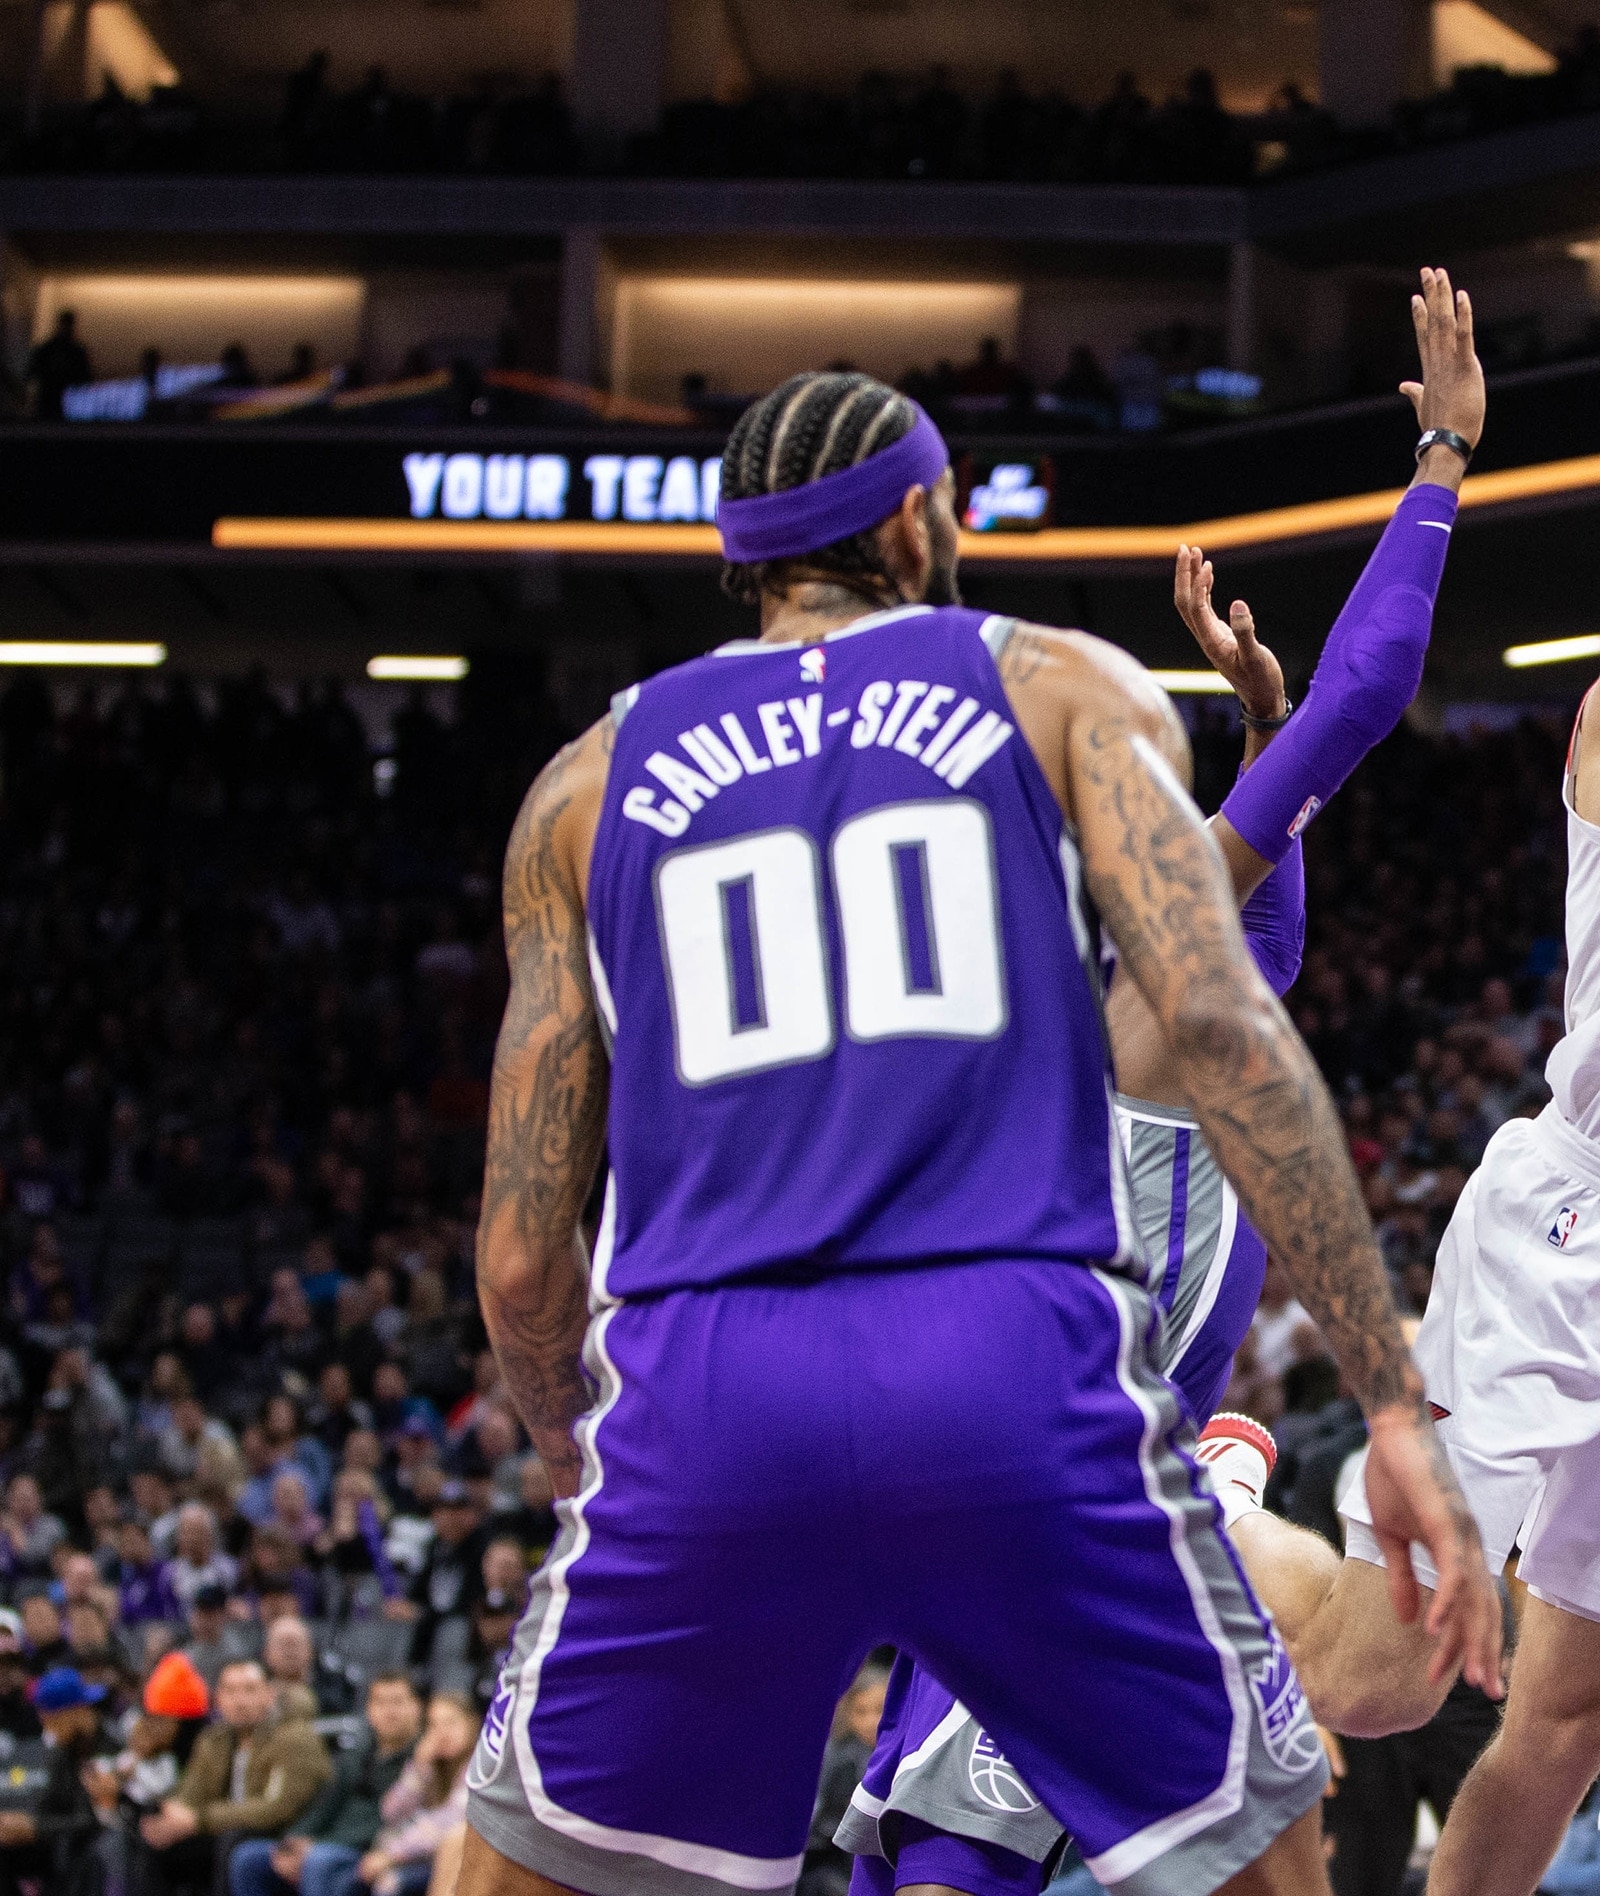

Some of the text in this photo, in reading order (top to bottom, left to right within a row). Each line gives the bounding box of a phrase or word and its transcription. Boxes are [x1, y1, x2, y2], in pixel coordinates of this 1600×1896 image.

[402, 452, 571, 520] YOUR
[622, 680, 1014, 838] CAULEY-STEIN
[650, 795, 1011, 1090] 00
